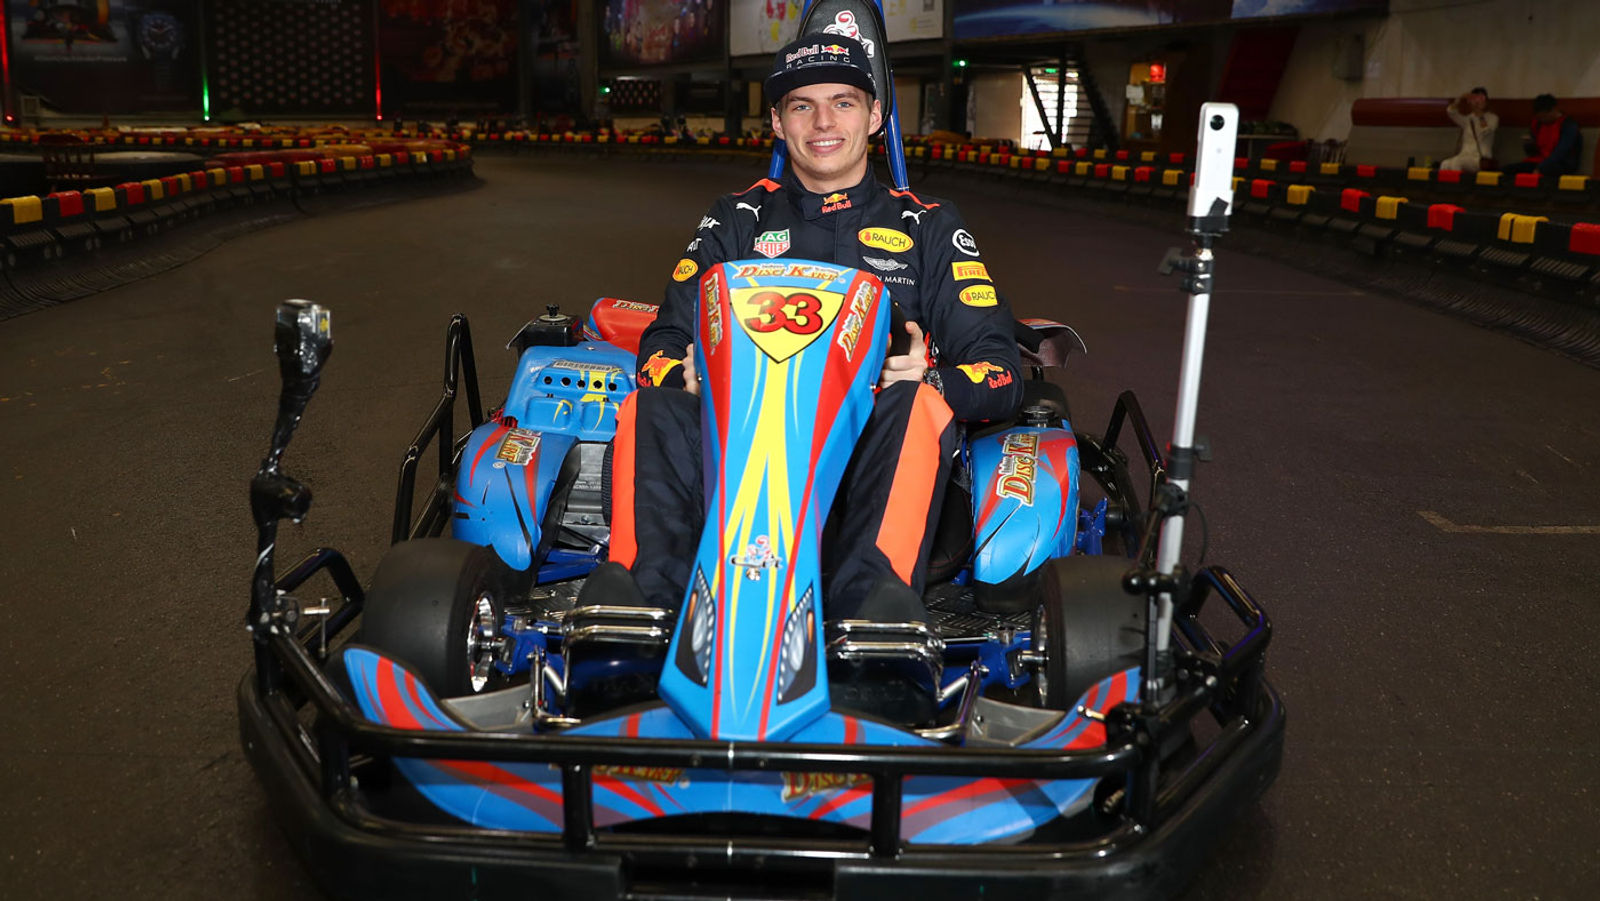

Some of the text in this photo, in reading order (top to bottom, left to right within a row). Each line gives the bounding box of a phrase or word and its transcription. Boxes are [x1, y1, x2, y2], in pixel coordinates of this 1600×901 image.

[786, 44, 819, 63] Red Bull
[786, 55, 850, 69] RACING
[821, 200, 852, 214] Red Bull
[760, 231, 788, 243] TAG
[872, 233, 907, 248] RAUCH
[885, 276, 915, 286] MARTIN
[972, 291, 996, 301] RAUC
[744, 292, 823, 335] 33
[988, 370, 1013, 389] Red Bull
